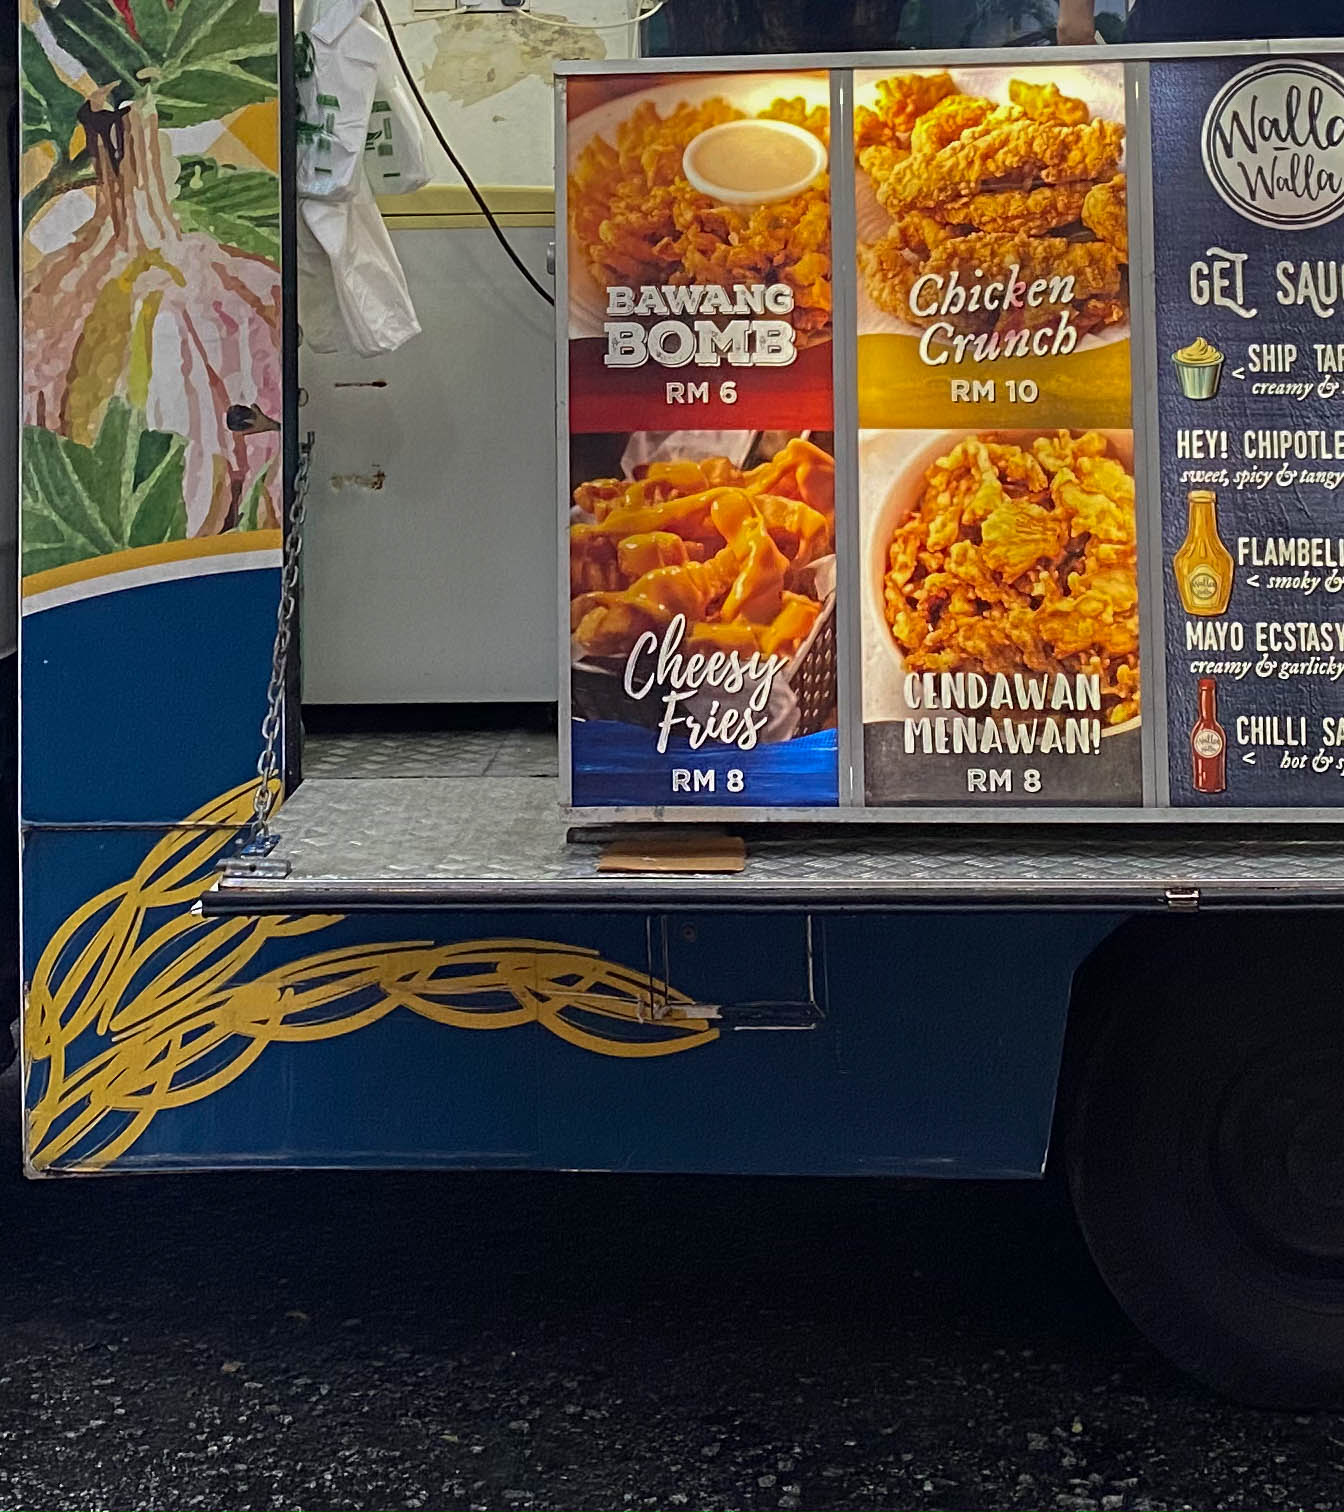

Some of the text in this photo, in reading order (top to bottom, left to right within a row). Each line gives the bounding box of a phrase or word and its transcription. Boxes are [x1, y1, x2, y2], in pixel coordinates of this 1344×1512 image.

[1237, 153, 1343, 201] Walla
[909, 263, 1076, 317] Chicken
[1190, 247, 1257, 318] GET
[606, 284, 795, 316] BAWANG
[604, 320, 798, 368] BOMB
[919, 310, 1078, 366] Crunch
[1248, 344, 1297, 373] SHIP
[666, 381, 738, 404] RM 6
[951, 379, 1039, 403] RM 10
[1251, 381, 1314, 400] creamy
[1317, 374, 1340, 399] &
[1177, 429, 1228, 460] HEY!
[1179, 464, 1344, 489] sweet, spicy & tangy
[1267, 572, 1321, 595] smoky
[1185, 621, 1244, 652] MAYO
[624, 613, 789, 711] Cheesy
[1190, 659, 1253, 680] creamy
[1256, 654, 1278, 677] &
[903, 672, 1101, 710] CENDAWAN
[657, 690, 768, 753] Fries
[904, 717, 1101, 755] MENAWAN!
[1236, 716, 1307, 746] CHILLI
[1280, 753, 1308, 769] hot
[1312, 750, 1334, 773] &
[672, 769, 744, 792] RM 8
[967, 769, 1042, 793] RM 8
